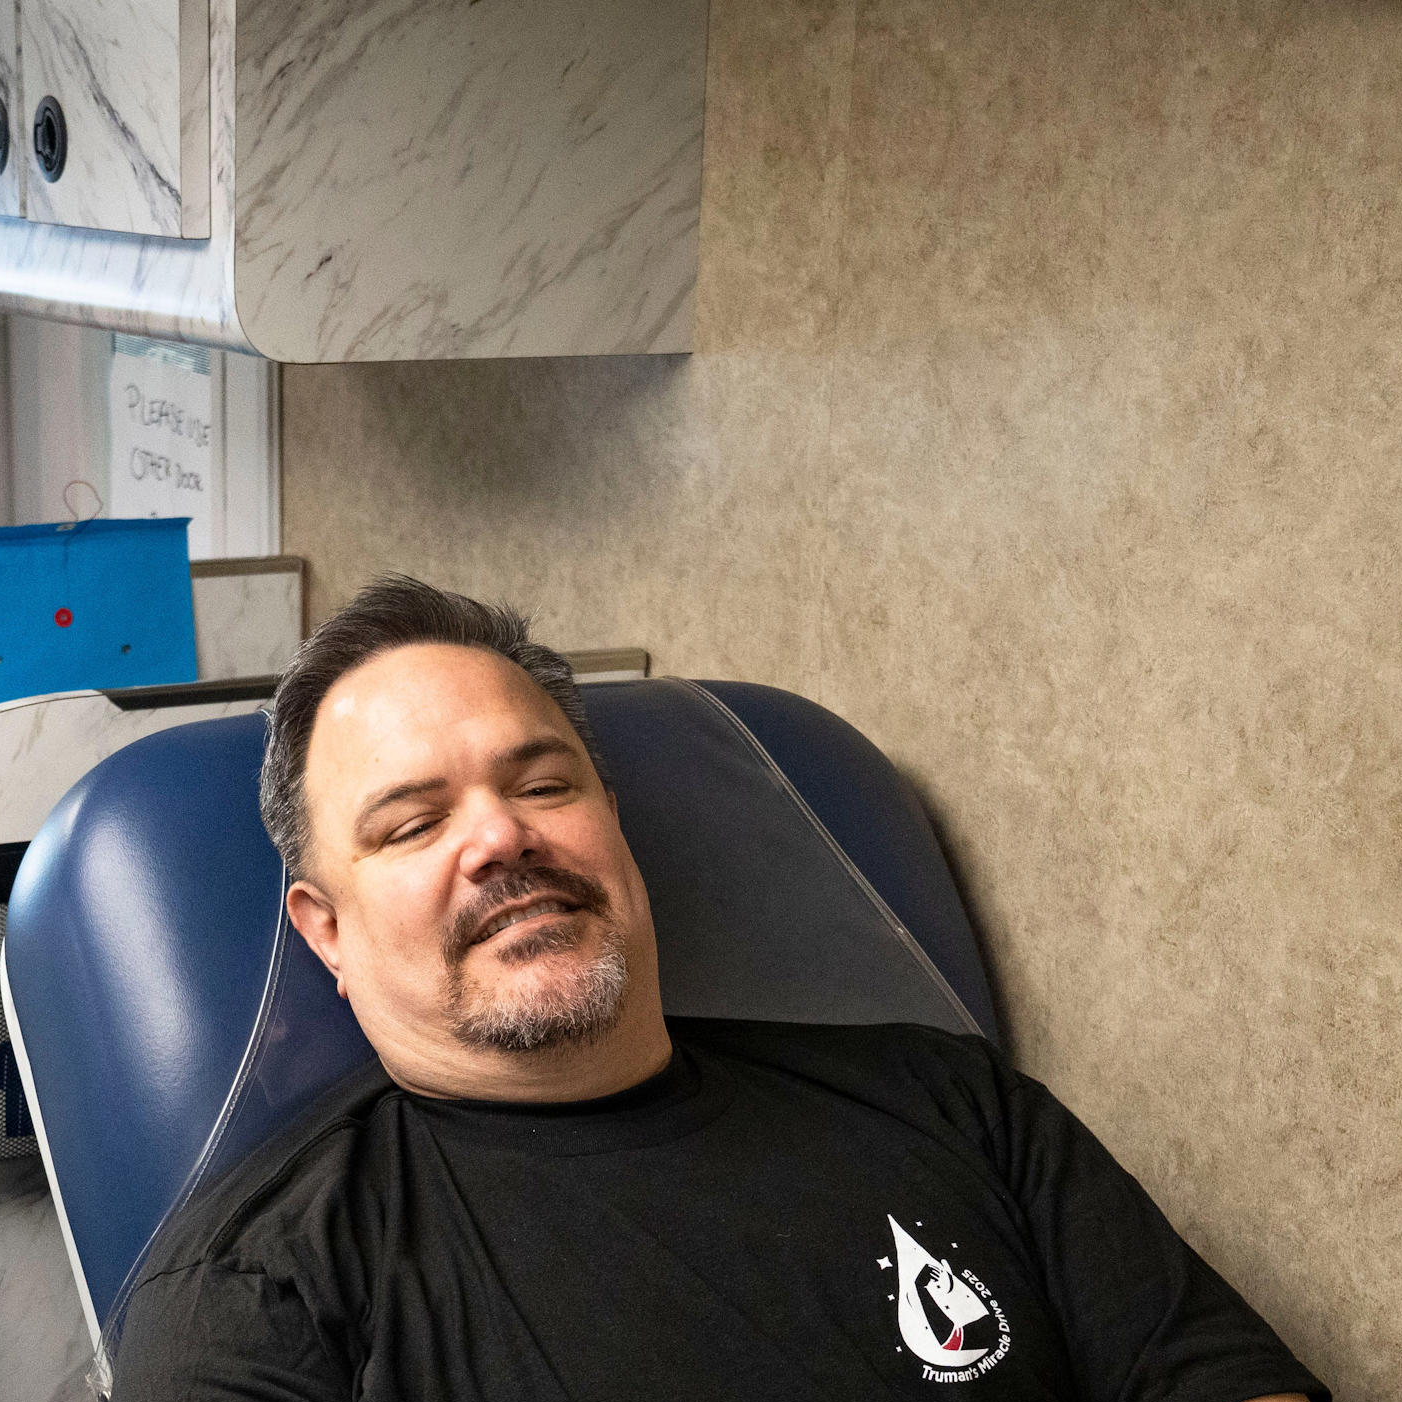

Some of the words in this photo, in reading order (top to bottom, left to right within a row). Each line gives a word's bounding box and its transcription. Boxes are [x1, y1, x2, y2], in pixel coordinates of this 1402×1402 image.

[124, 384, 185, 437] PLEASE
[961, 1268, 992, 1299] 2025
[989, 1299, 1011, 1333] Drive
[977, 1334, 1011, 1375] Miracle
[922, 1364, 980, 1383] Truman's
